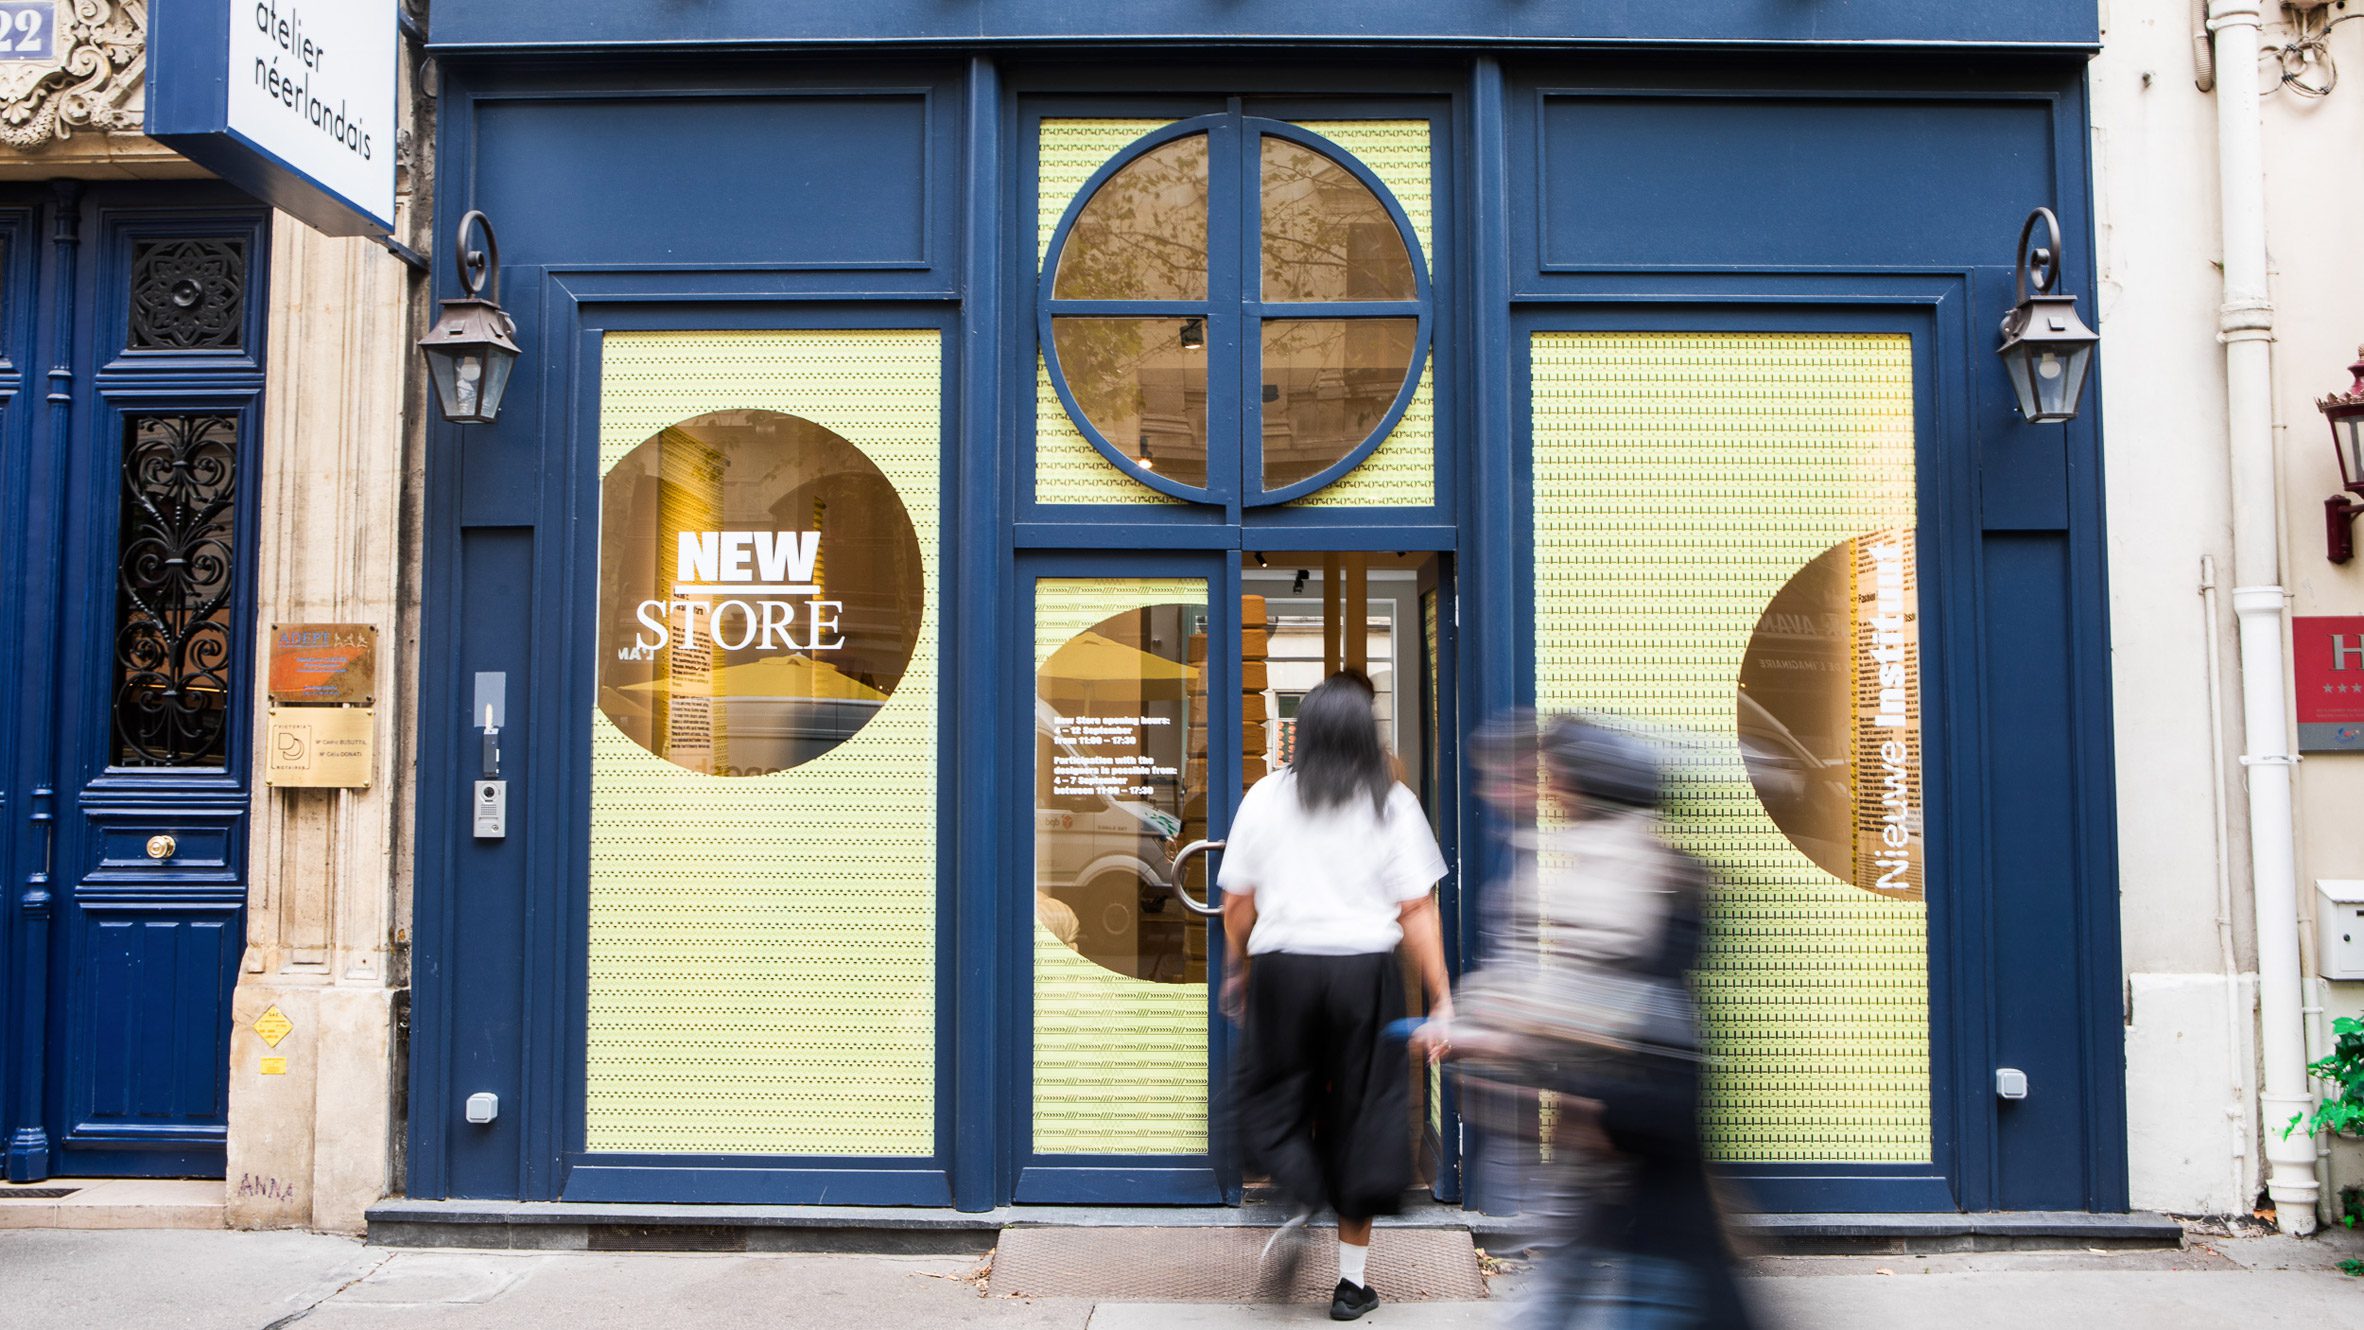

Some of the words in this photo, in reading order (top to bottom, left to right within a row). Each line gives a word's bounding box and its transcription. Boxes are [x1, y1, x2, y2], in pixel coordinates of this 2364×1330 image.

[256, 0, 324, 73] atelier
[255, 56, 371, 161] néerlandais
[677, 531, 821, 582] NEW
[636, 599, 845, 651] STORE
[1053, 716, 1074, 725] New
[1075, 716, 1101, 725] Store
[1102, 716, 1140, 726] opening
[1140, 716, 1171, 725] hours:
[1070, 727, 1082, 735] 12
[1082, 727, 1133, 736] September
[1053, 736, 1077, 745] from
[1053, 756, 1114, 765] Participation
[1114, 756, 1137, 764] with
[1138, 756, 1154, 764] the
[1053, 766, 1099, 775] designers
[1100, 766, 1110, 775] is
[1110, 766, 1151, 776] possible
[1077, 777, 1128, 786] September
[1053, 786, 1094, 795] between
[1875, 740, 1909, 890] Nieuwe
